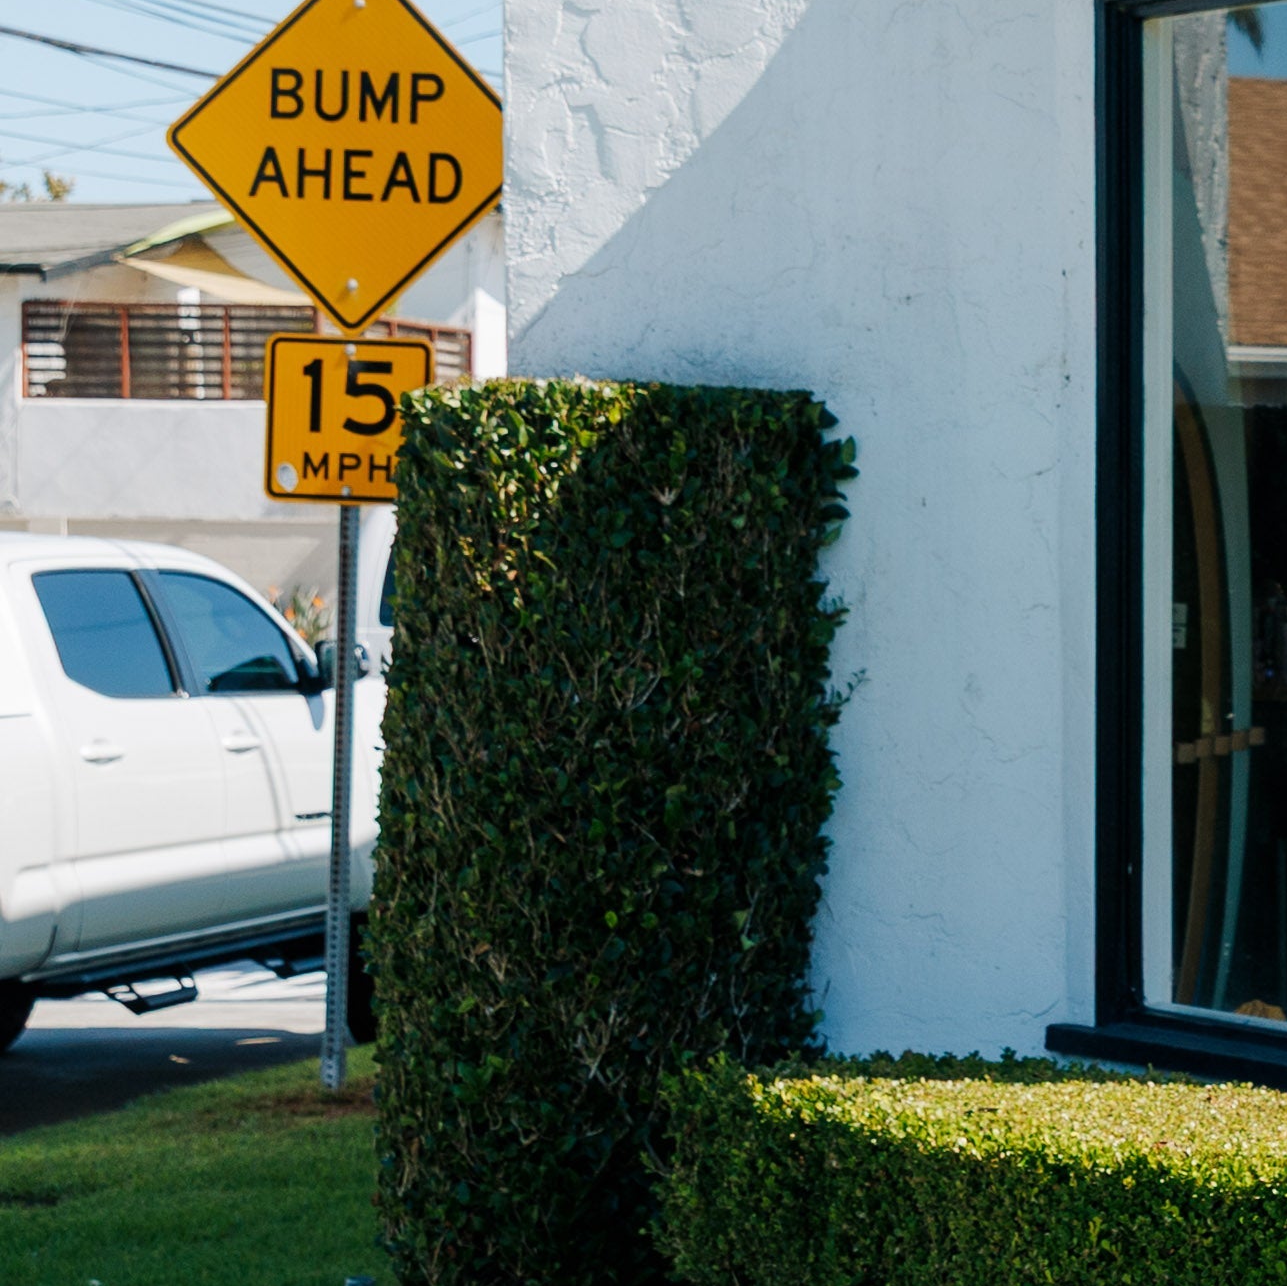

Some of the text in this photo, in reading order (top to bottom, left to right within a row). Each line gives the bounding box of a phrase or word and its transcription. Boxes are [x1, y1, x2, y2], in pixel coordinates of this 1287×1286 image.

[270, 68, 445, 124] BUMP
[249, 146, 463, 204] AHEAD
[303, 358, 396, 436] 15
[302, 452, 392, 483] MPH
